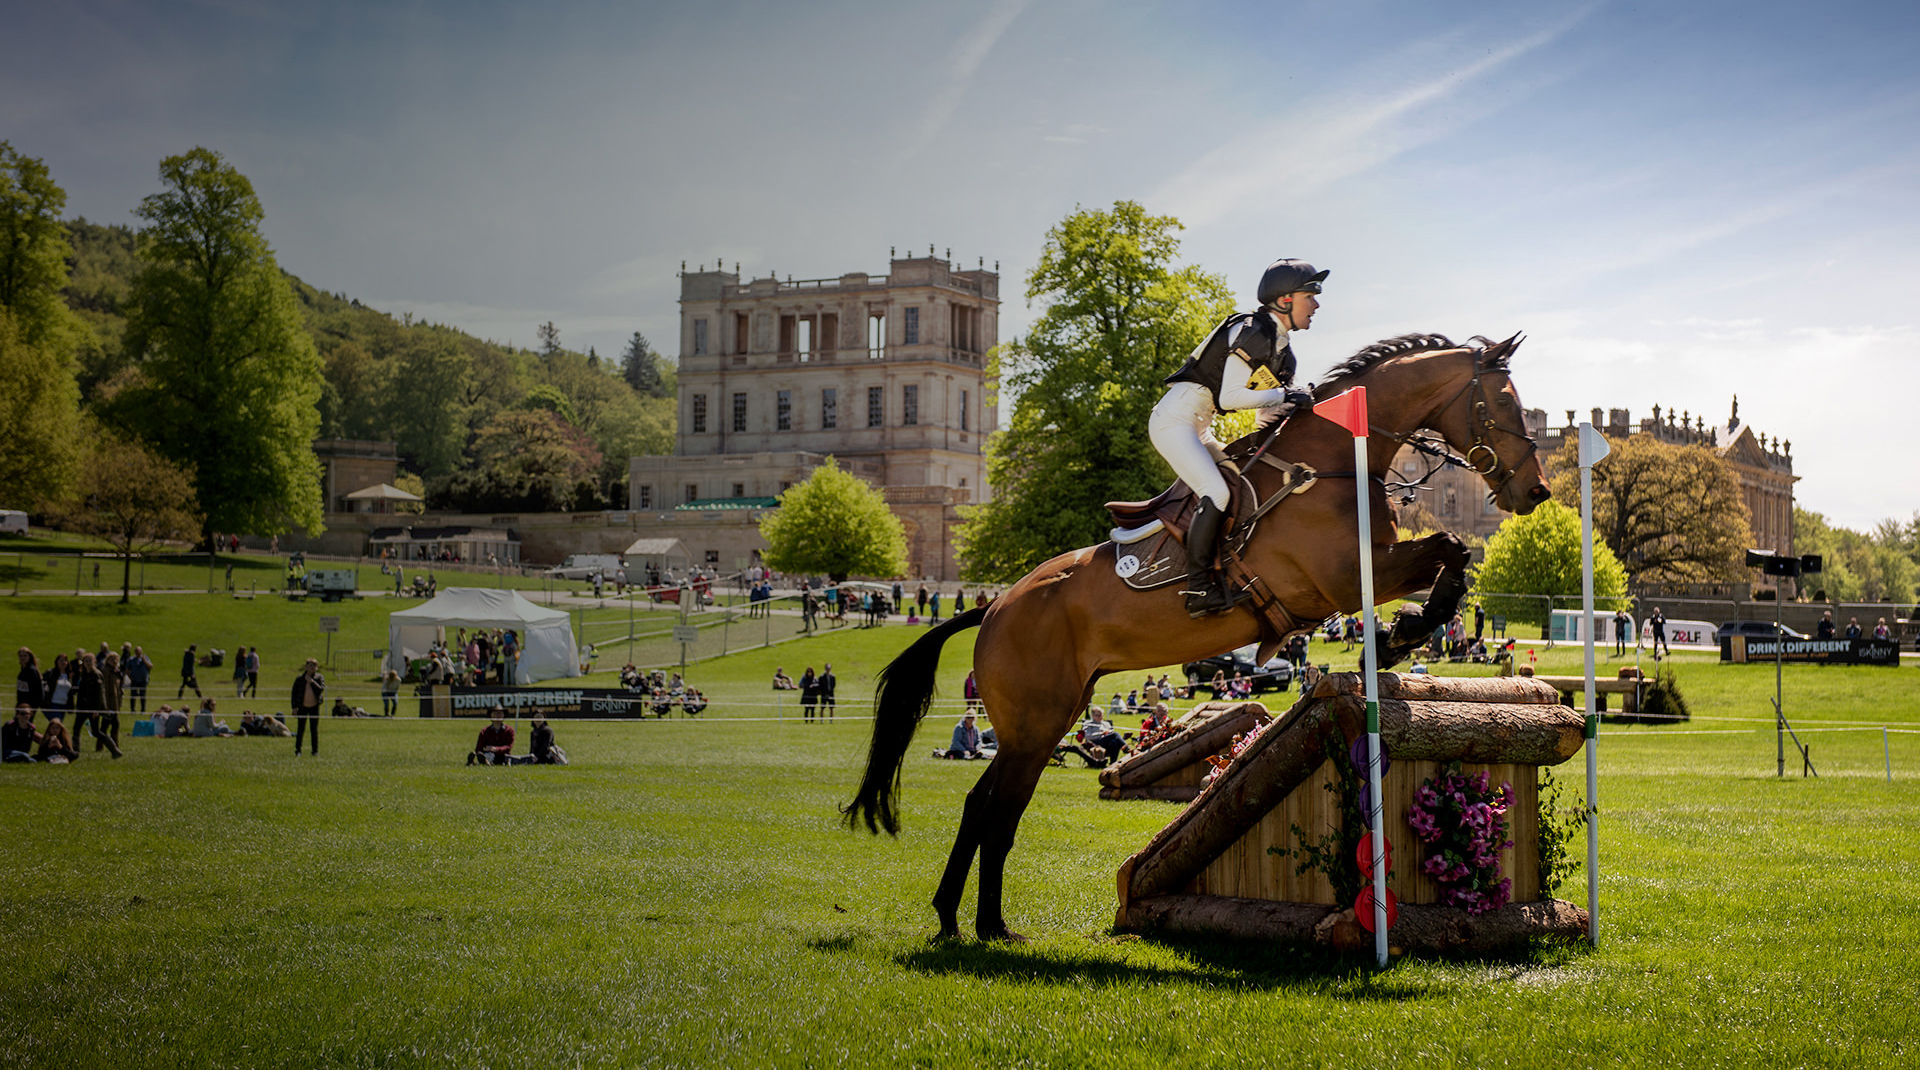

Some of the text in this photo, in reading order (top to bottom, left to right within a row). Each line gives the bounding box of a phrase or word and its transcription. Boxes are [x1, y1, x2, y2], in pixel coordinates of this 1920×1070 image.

[1747, 639, 1852, 654] DRINK DIFFERENT
[454, 691, 584, 709] DRINK DIFFERENT
